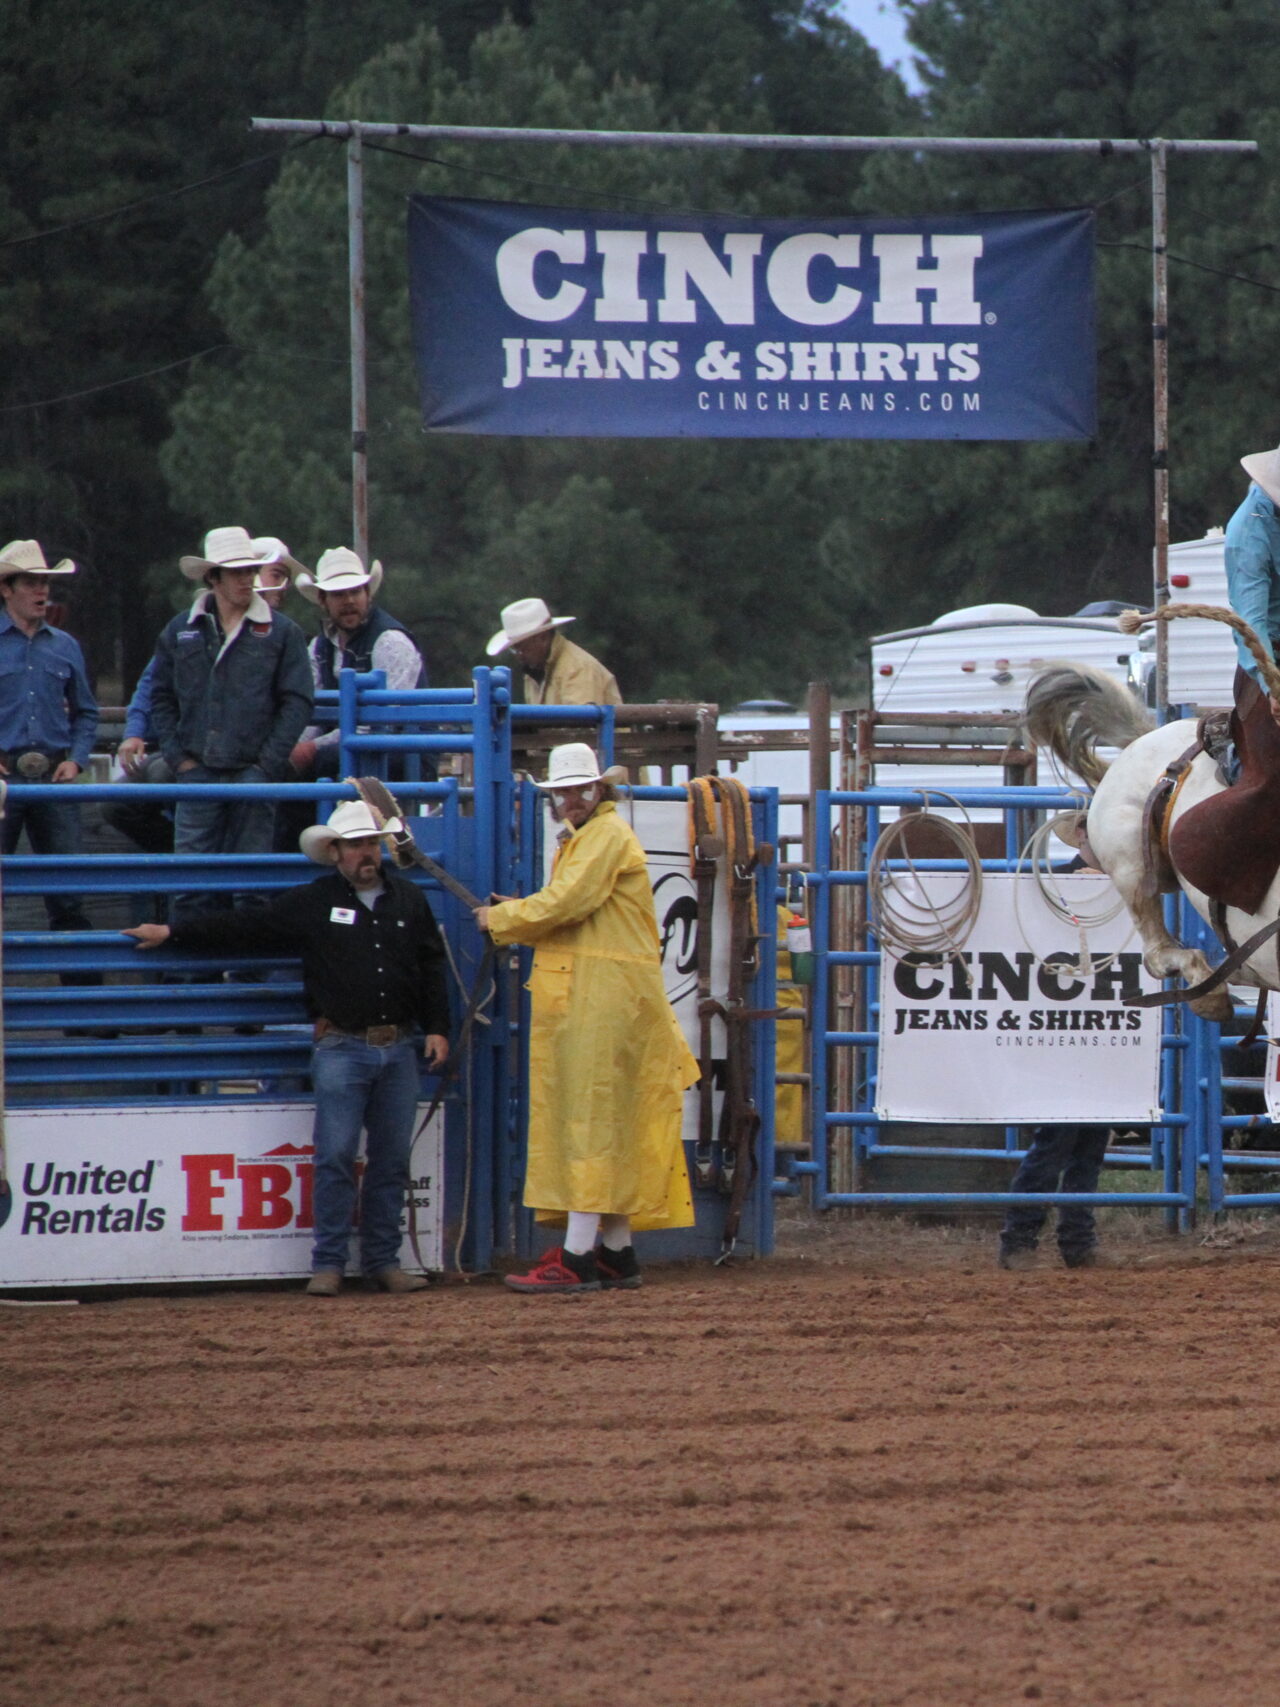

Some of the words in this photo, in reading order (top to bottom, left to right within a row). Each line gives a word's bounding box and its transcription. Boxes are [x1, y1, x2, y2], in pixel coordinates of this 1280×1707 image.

[496, 227, 983, 326] CINCH
[502, 338, 680, 389] JEANS
[695, 340, 741, 381] &
[755, 341, 980, 382] SHIRTS
[698, 391, 980, 412] CINCHJEANS.COM
[894, 951, 1144, 1001] CINCH
[894, 1008, 988, 1034] JEANS
[996, 1009, 1021, 1030] &
[1028, 1009, 1142, 1030] SHIRTS
[996, 1035, 1142, 1047] CINCHJEANS.COM
[22, 1160, 155, 1197] United
[21, 1199, 166, 1235] Rentals
